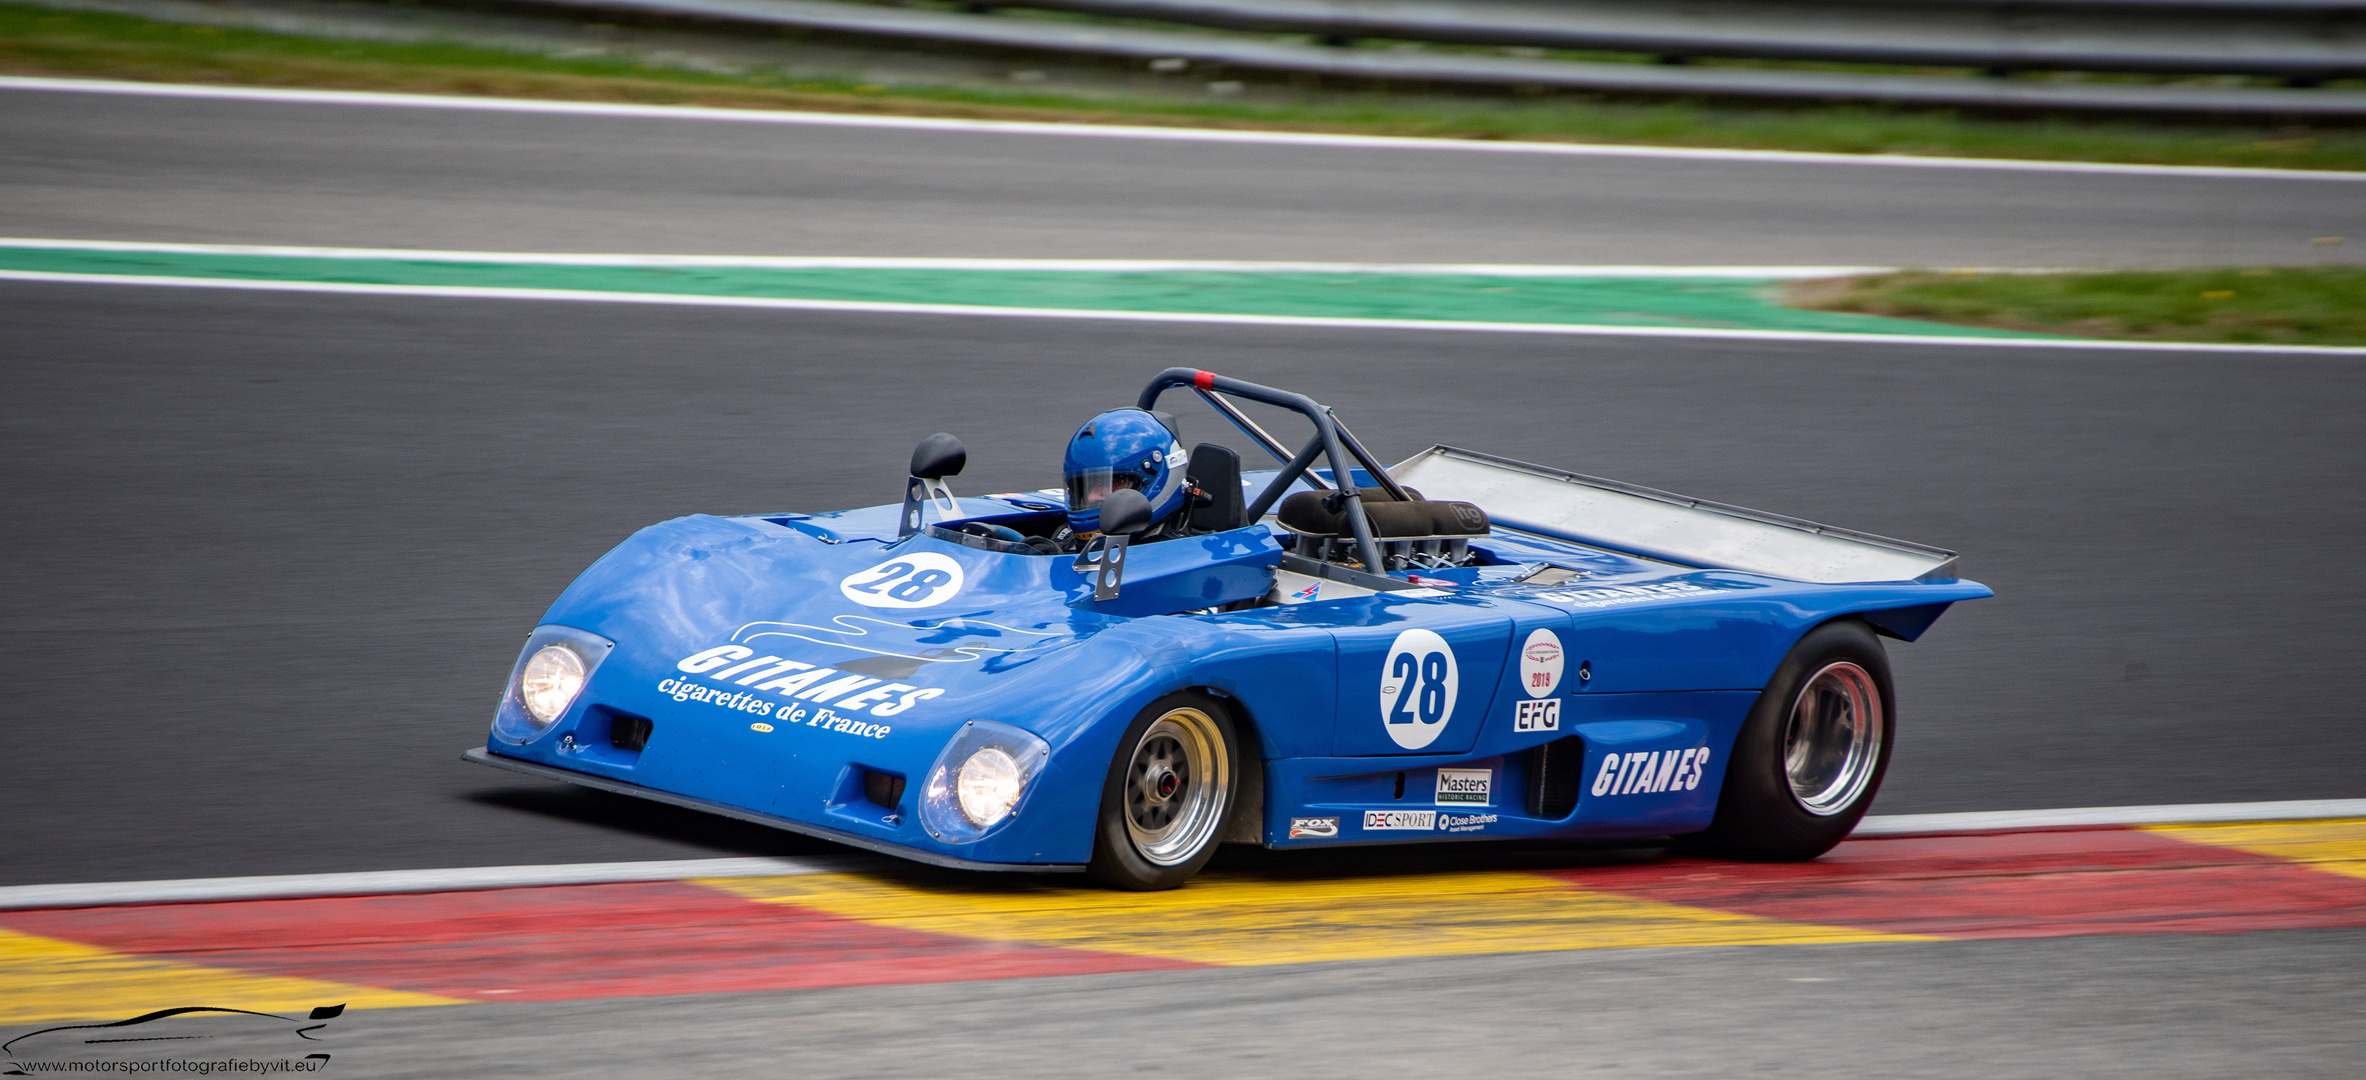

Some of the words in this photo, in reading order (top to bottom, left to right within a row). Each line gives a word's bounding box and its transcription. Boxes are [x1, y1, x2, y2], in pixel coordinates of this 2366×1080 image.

[848, 562, 952, 603] 28
[1536, 581, 1702, 602] GITANES
[676, 644, 946, 717] GITANES
[1389, 651, 1448, 725] 28
[1531, 672, 1551, 688] 2019
[658, 676, 775, 717] cigarettes
[776, 701, 807, 723] de
[807, 707, 892, 739] France
[1518, 701, 1557, 730] EFG
[1591, 746, 1711, 797] GITANES
[1440, 774, 1488, 792] Masters
[1438, 793, 1464, 801] HISTORIC
[1465, 793, 1487, 801] RACING
[1292, 819, 1335, 827] FOX
[1365, 813, 1394, 828] IDEC
[1394, 813, 1435, 828] SPORT
[1450, 816, 1469, 827] Close
[1469, 814, 1498, 825] Brothers
